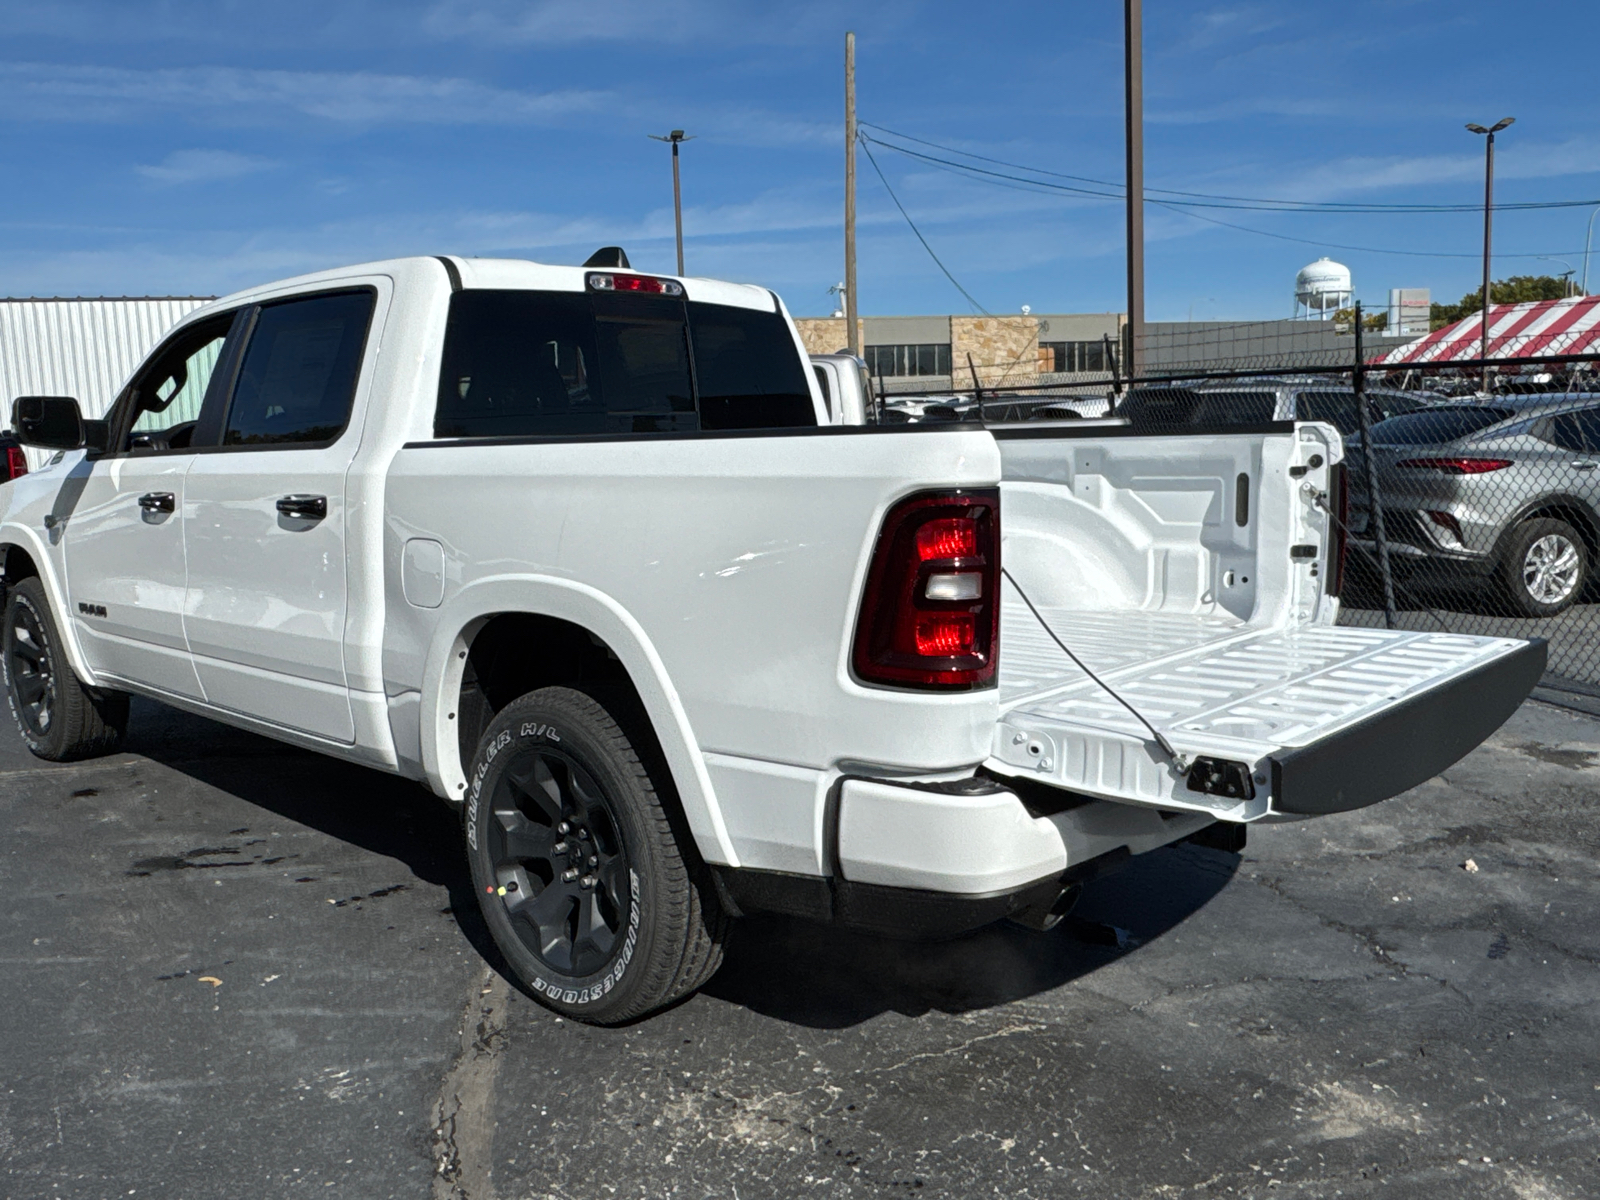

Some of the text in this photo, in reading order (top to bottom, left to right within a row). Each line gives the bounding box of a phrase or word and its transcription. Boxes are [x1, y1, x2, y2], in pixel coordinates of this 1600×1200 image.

[78, 602, 107, 618] RAM
[467, 722, 560, 851] DUELER H/L
[531, 867, 640, 1004] BRIDGESTONE
